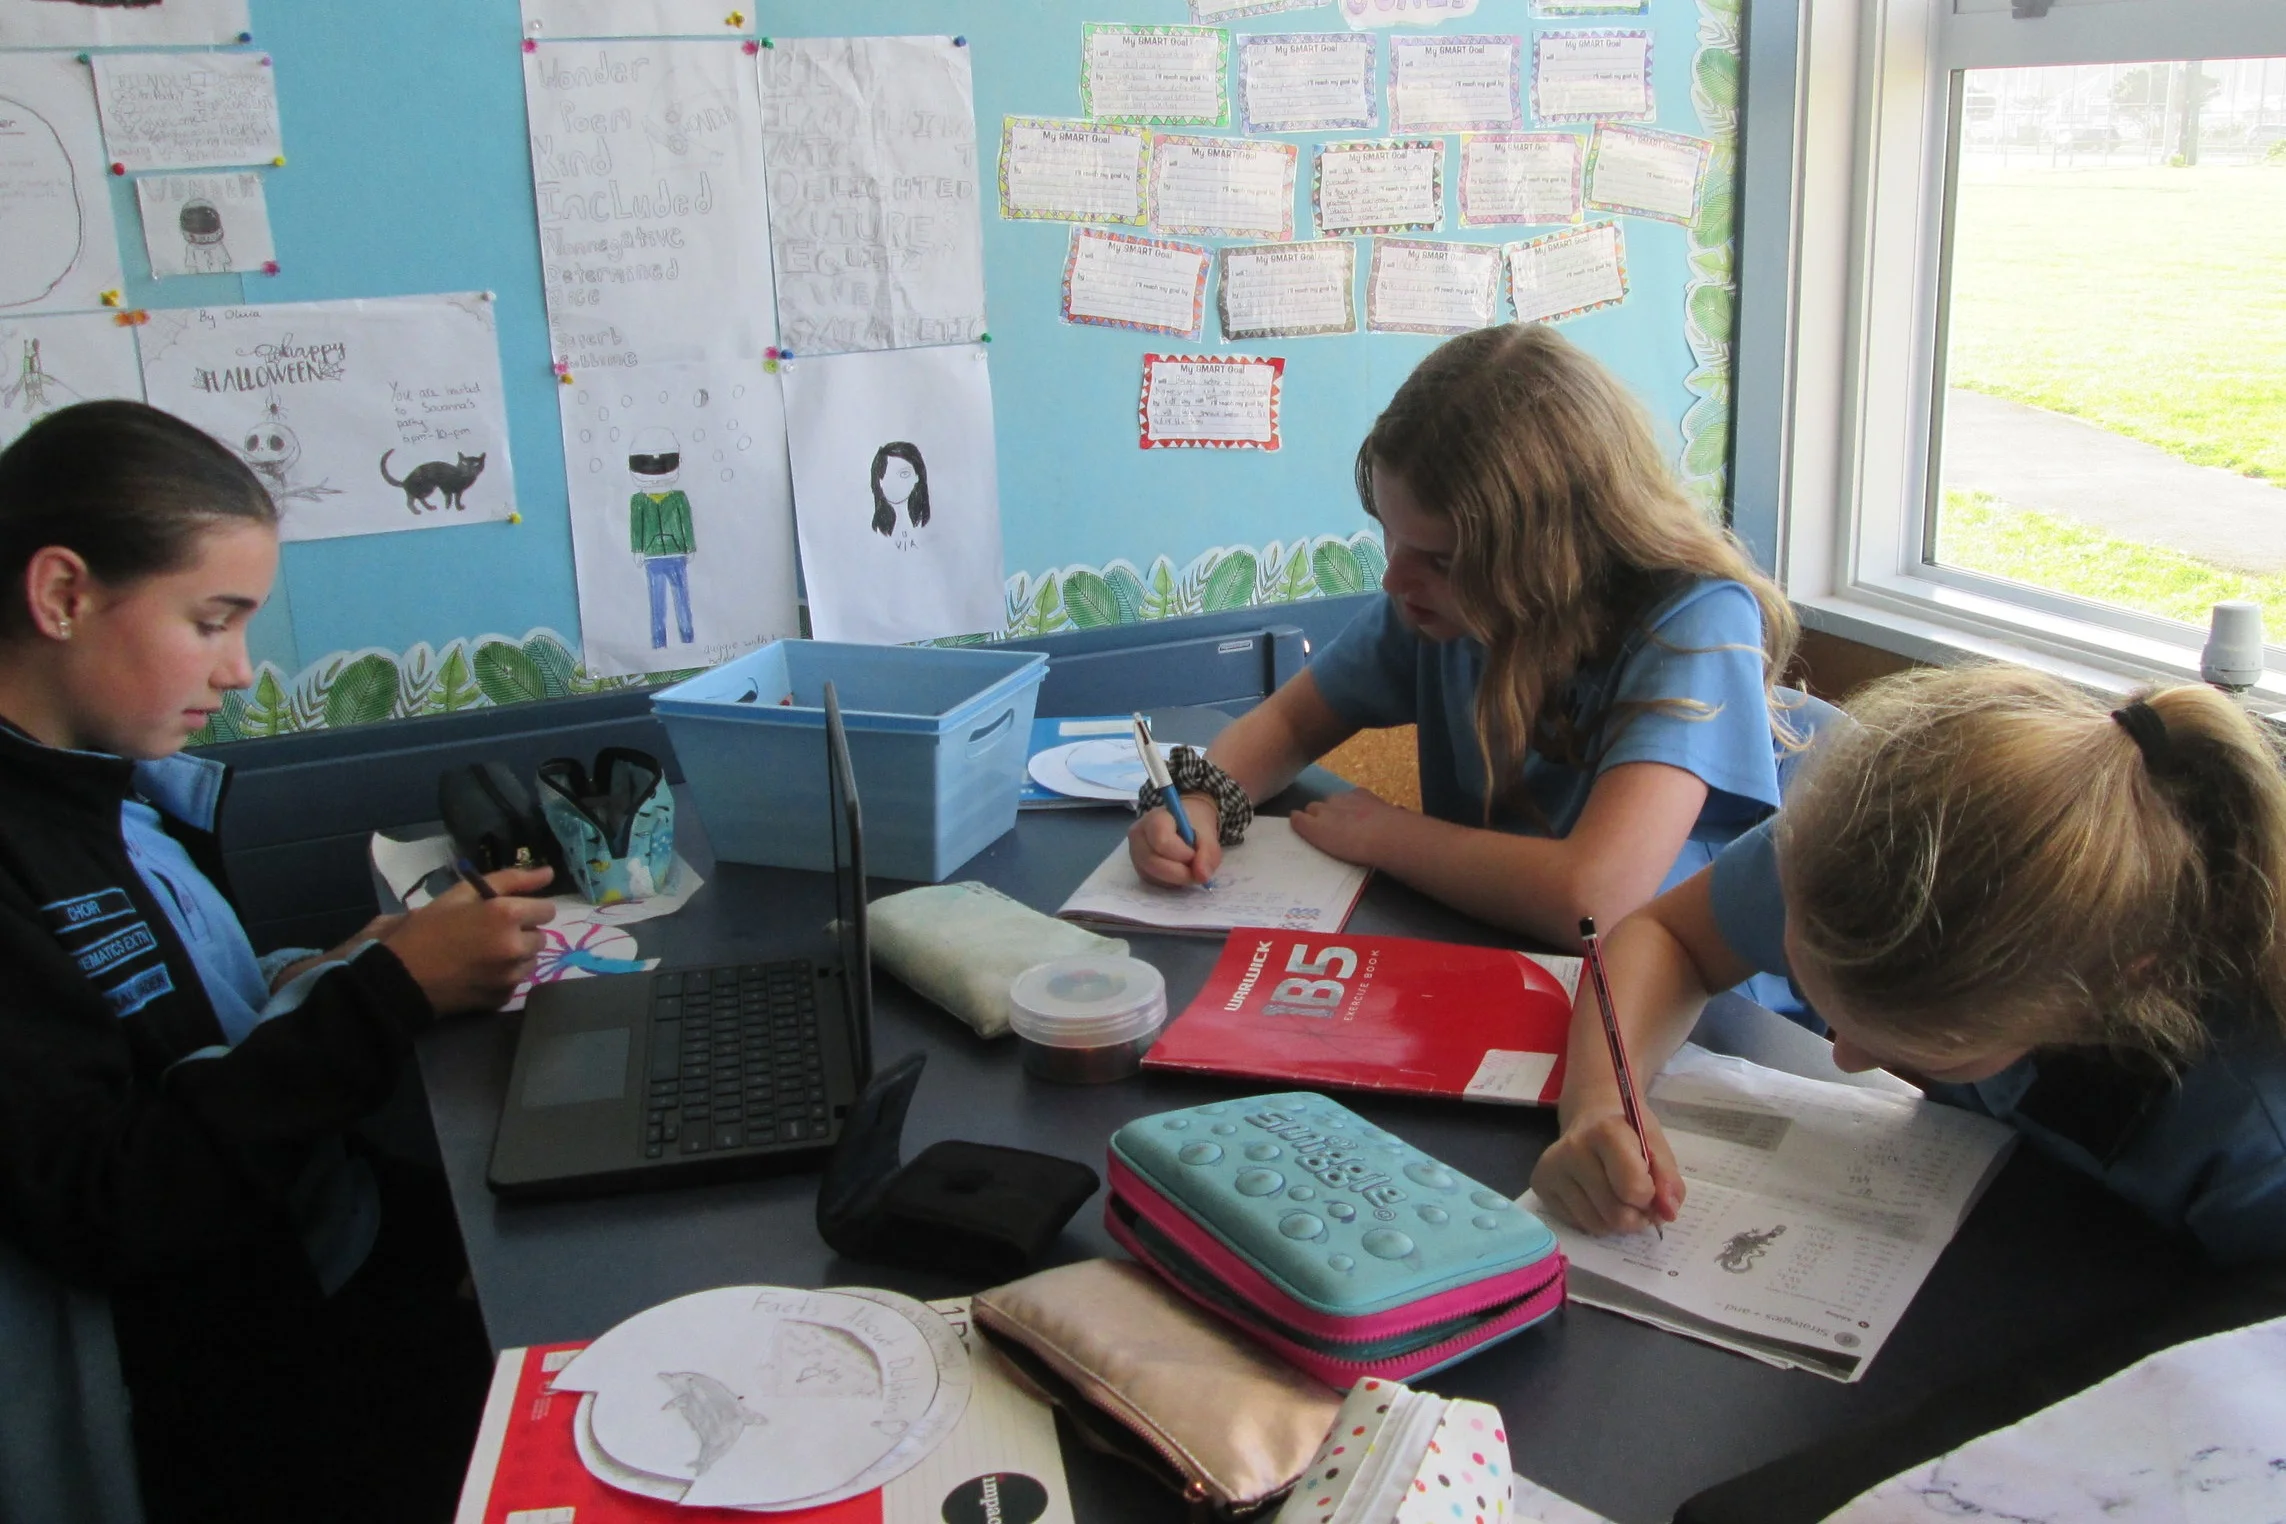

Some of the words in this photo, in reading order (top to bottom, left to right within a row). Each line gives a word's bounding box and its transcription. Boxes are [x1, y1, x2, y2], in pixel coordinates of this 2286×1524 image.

[1122, 36, 1136, 48] My
[1565, 40, 1577, 50] My
[1275, 45, 1288, 56] My
[1425, 46, 1437, 58] My
[1042, 130, 1056, 143] My
[1191, 147, 1205, 160] My
[1108, 242, 1121, 254] My
[1256, 255, 1269, 266] My
[1180, 364, 1193, 375] My
[202, 360, 324, 393] HALLOWEEN
[1224, 940, 1274, 1012] WARWICK
[1261, 943, 1358, 1019] 1B5
[1343, 982, 1370, 1021] EXERCISE
[1364, 949, 1381, 979] BOOK
